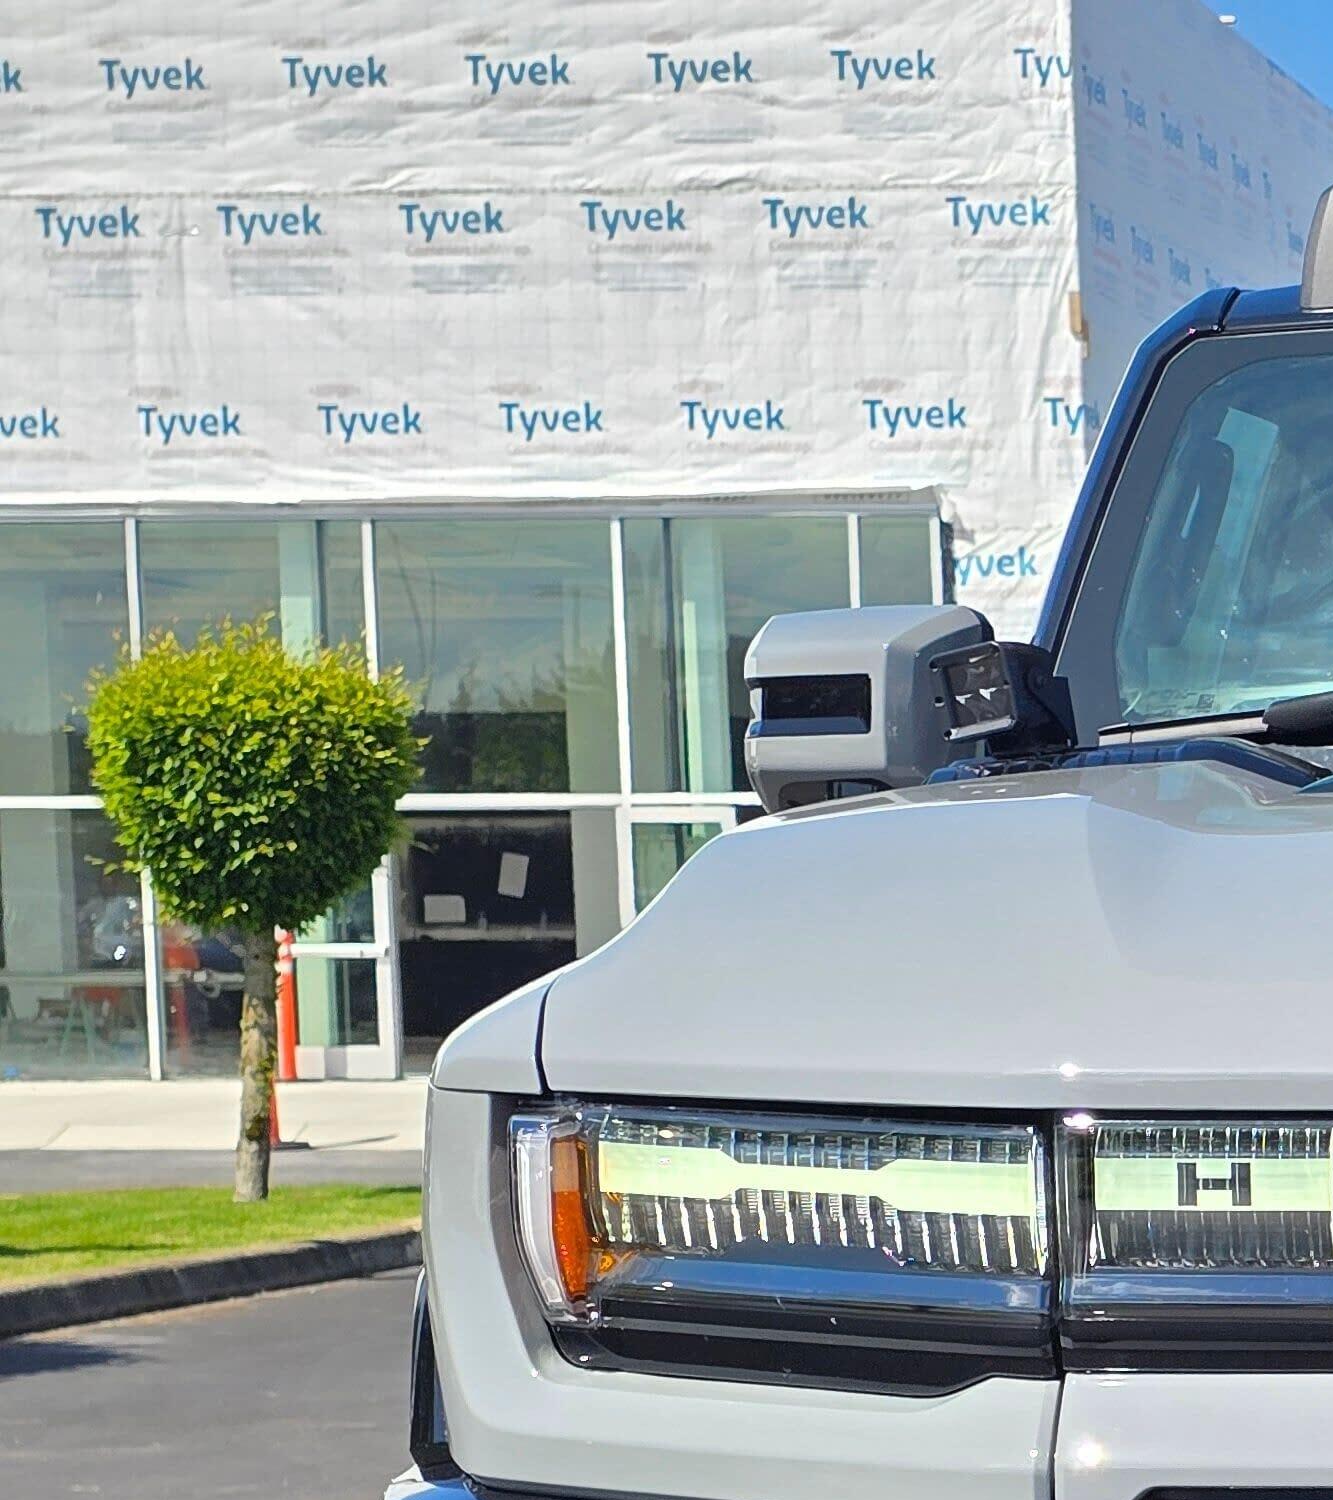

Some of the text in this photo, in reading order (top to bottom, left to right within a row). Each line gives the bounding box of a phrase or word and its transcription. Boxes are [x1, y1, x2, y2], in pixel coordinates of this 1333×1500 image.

[98, 58, 207, 99] Tyvek
[281, 56, 388, 97] Tyvek
[464, 53, 571, 95] Tyvek
[647, 51, 754, 93] Tyvek
[830, 48, 936, 90] Tyvek
[1013, 47, 1072, 87] Tyv
[35, 205, 140, 247] Tyvek
[217, 203, 322, 245] Tyvek
[398, 201, 505, 242] Tyvek
[580, 199, 687, 240] Tyvek
[762, 196, 868, 238] Tyvek
[945, 195, 1051, 235] Tyvek
[0, 405, 60, 439] vek
[137, 403, 241, 445] Tyvek
[317, 401, 422, 443] Tyvek
[499, 400, 603, 441] Tyvek
[680, 399, 785, 439] Tyvek
[862, 398, 967, 437] Tyvek
[953, 545, 1037, 586] yvek
